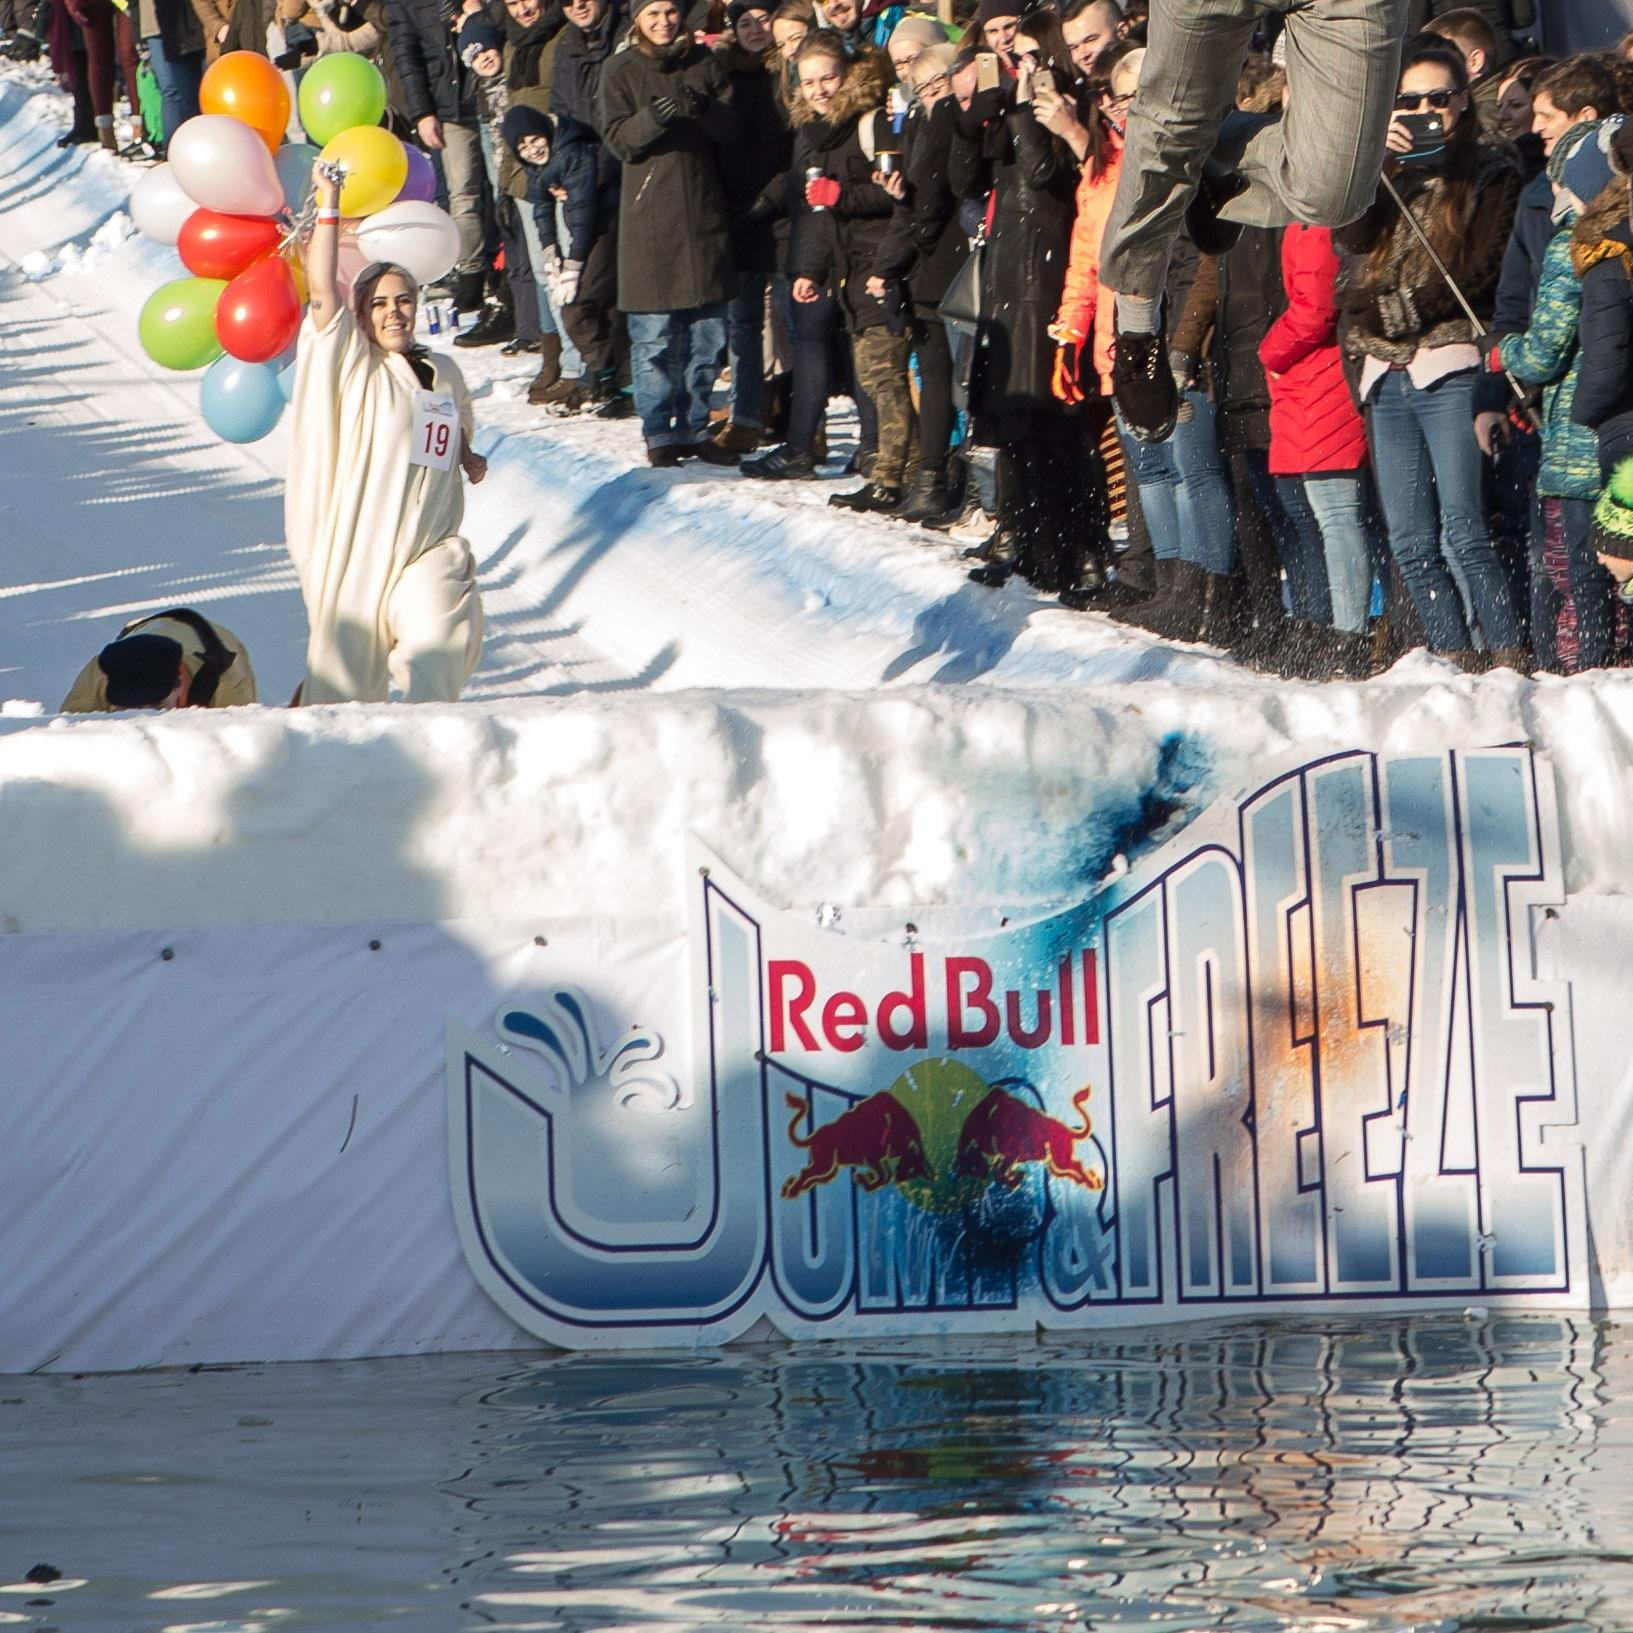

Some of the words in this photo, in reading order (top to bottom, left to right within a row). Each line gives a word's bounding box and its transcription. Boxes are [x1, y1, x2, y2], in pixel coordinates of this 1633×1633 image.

[424, 421, 450, 457] 19
[768, 952, 929, 1053] Red
[945, 948, 1100, 1050] Bull
[1105, 744, 1567, 1304] FREEZE
